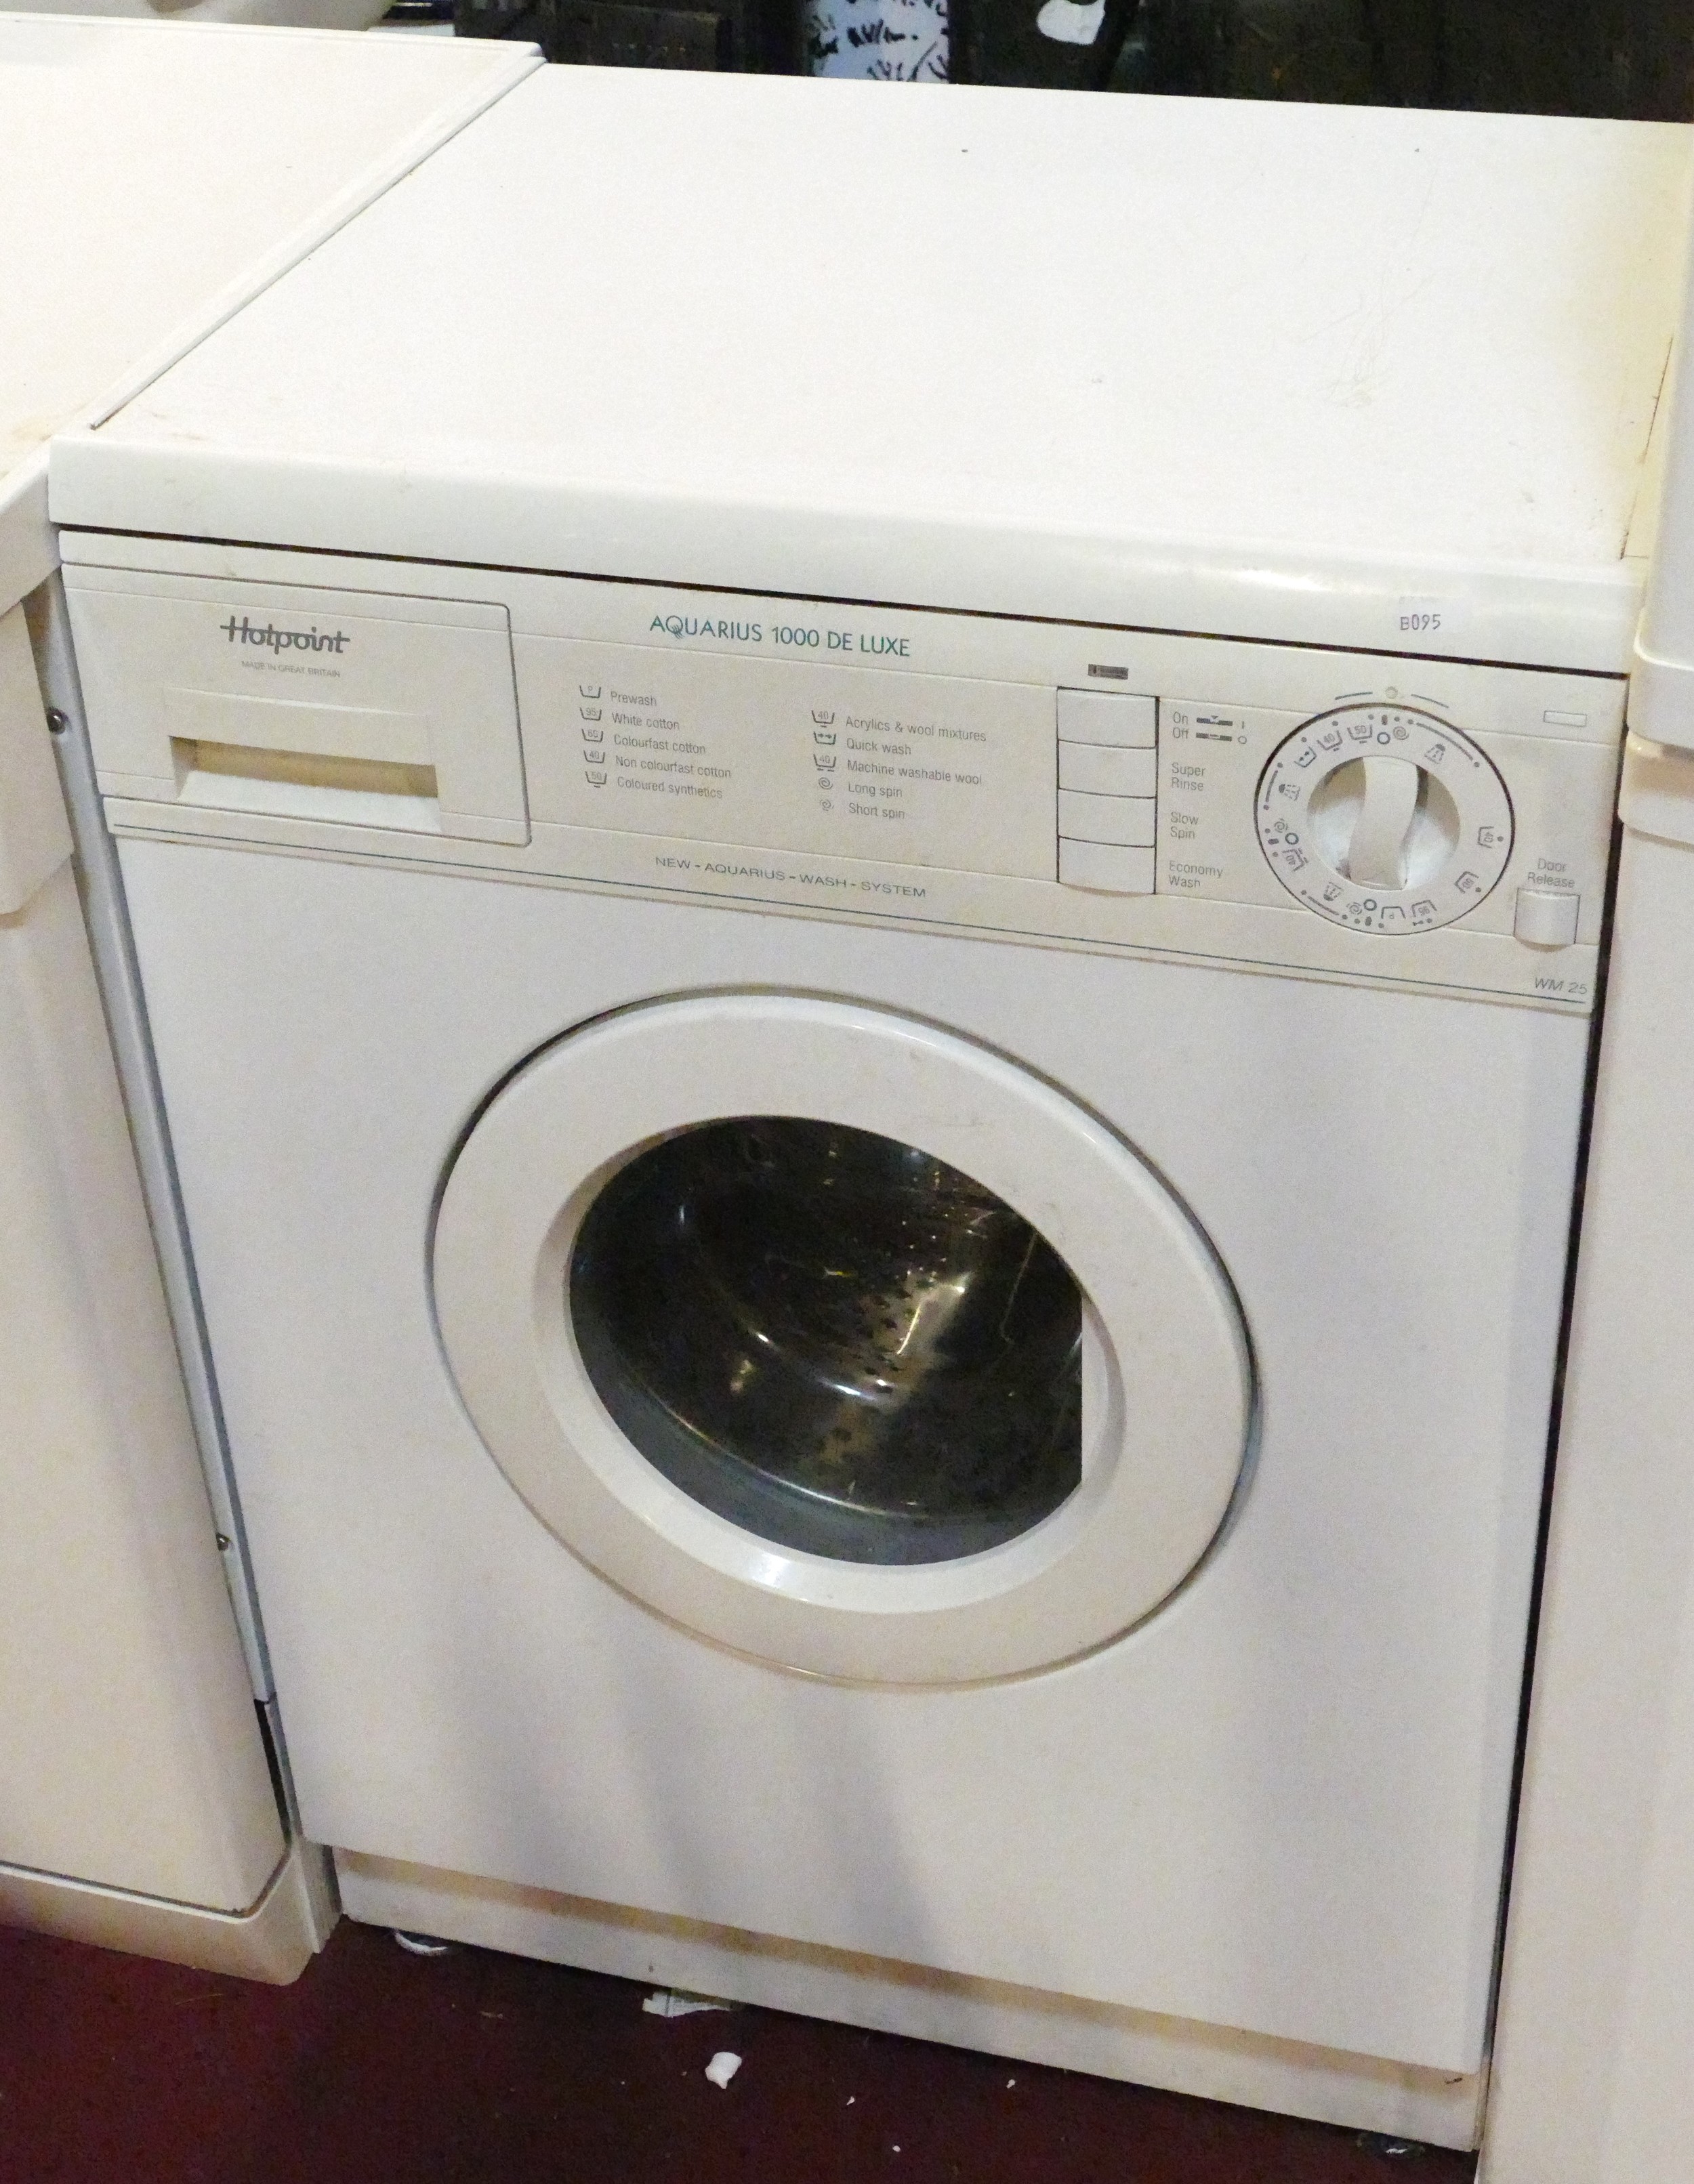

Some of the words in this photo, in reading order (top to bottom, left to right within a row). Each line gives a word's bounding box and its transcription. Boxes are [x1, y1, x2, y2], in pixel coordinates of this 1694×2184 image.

[220, 615, 350, 654] Hotpoint
[650, 615, 762, 642] AQUARIUS
[772, 627, 820, 647] 1000
[827, 631, 853, 651] DE
[860, 634, 911, 657] LUXE
[242, 661, 265, 671] MADE
[278, 665, 304, 675] GREAT
[307, 667, 341, 677] BRITAIN
[611, 690, 657, 707] Prewash
[611, 712, 642, 726] White
[646, 717, 680, 731] cotton
[1173, 711, 1189, 724] On
[846, 716, 890, 732] Acrylics
[894, 721, 903, 733] &
[907, 724, 934, 736] wool
[938, 727, 987, 742] mixtures
[1172, 727, 1189, 739] Off
[614, 734, 669, 751] Colourfast
[672, 742, 706, 755] cotton
[846, 738, 878, 752] Quick
[882, 744, 911, 755] wash
[615, 755, 637, 768] Non
[640, 758, 695, 774] colourfast
[697, 765, 732, 778] cotton
[847, 759, 894, 775] Machine
[898, 766, 951, 782] washable
[955, 774, 983, 785] wool
[1172, 762, 1206, 777] Super
[617, 776, 665, 793] Coloured
[668, 782, 723, 799] synthetics
[848, 783, 876, 797] Long
[880, 786, 903, 798] spin
[1171, 777, 1204, 791] Rinse
[849, 802, 880, 817] Short
[882, 807, 905, 820] spin
[1170, 812, 1199, 825] Slow
[1170, 826, 1195, 839] Spin
[1169, 860, 1223, 879] Economy
[1537, 858, 1567, 873] Door
[655, 856, 690, 869] NEW
[705, 862, 785, 881] AQUARIUS
[799, 874, 847, 888] WASH
[861, 881, 926, 898] SYSTEM
[1169, 875, 1201, 888] Wash
[1527, 872, 1575, 888] Release
[1535, 977, 1565, 991] WM
[1568, 982, 1588, 994] 25
